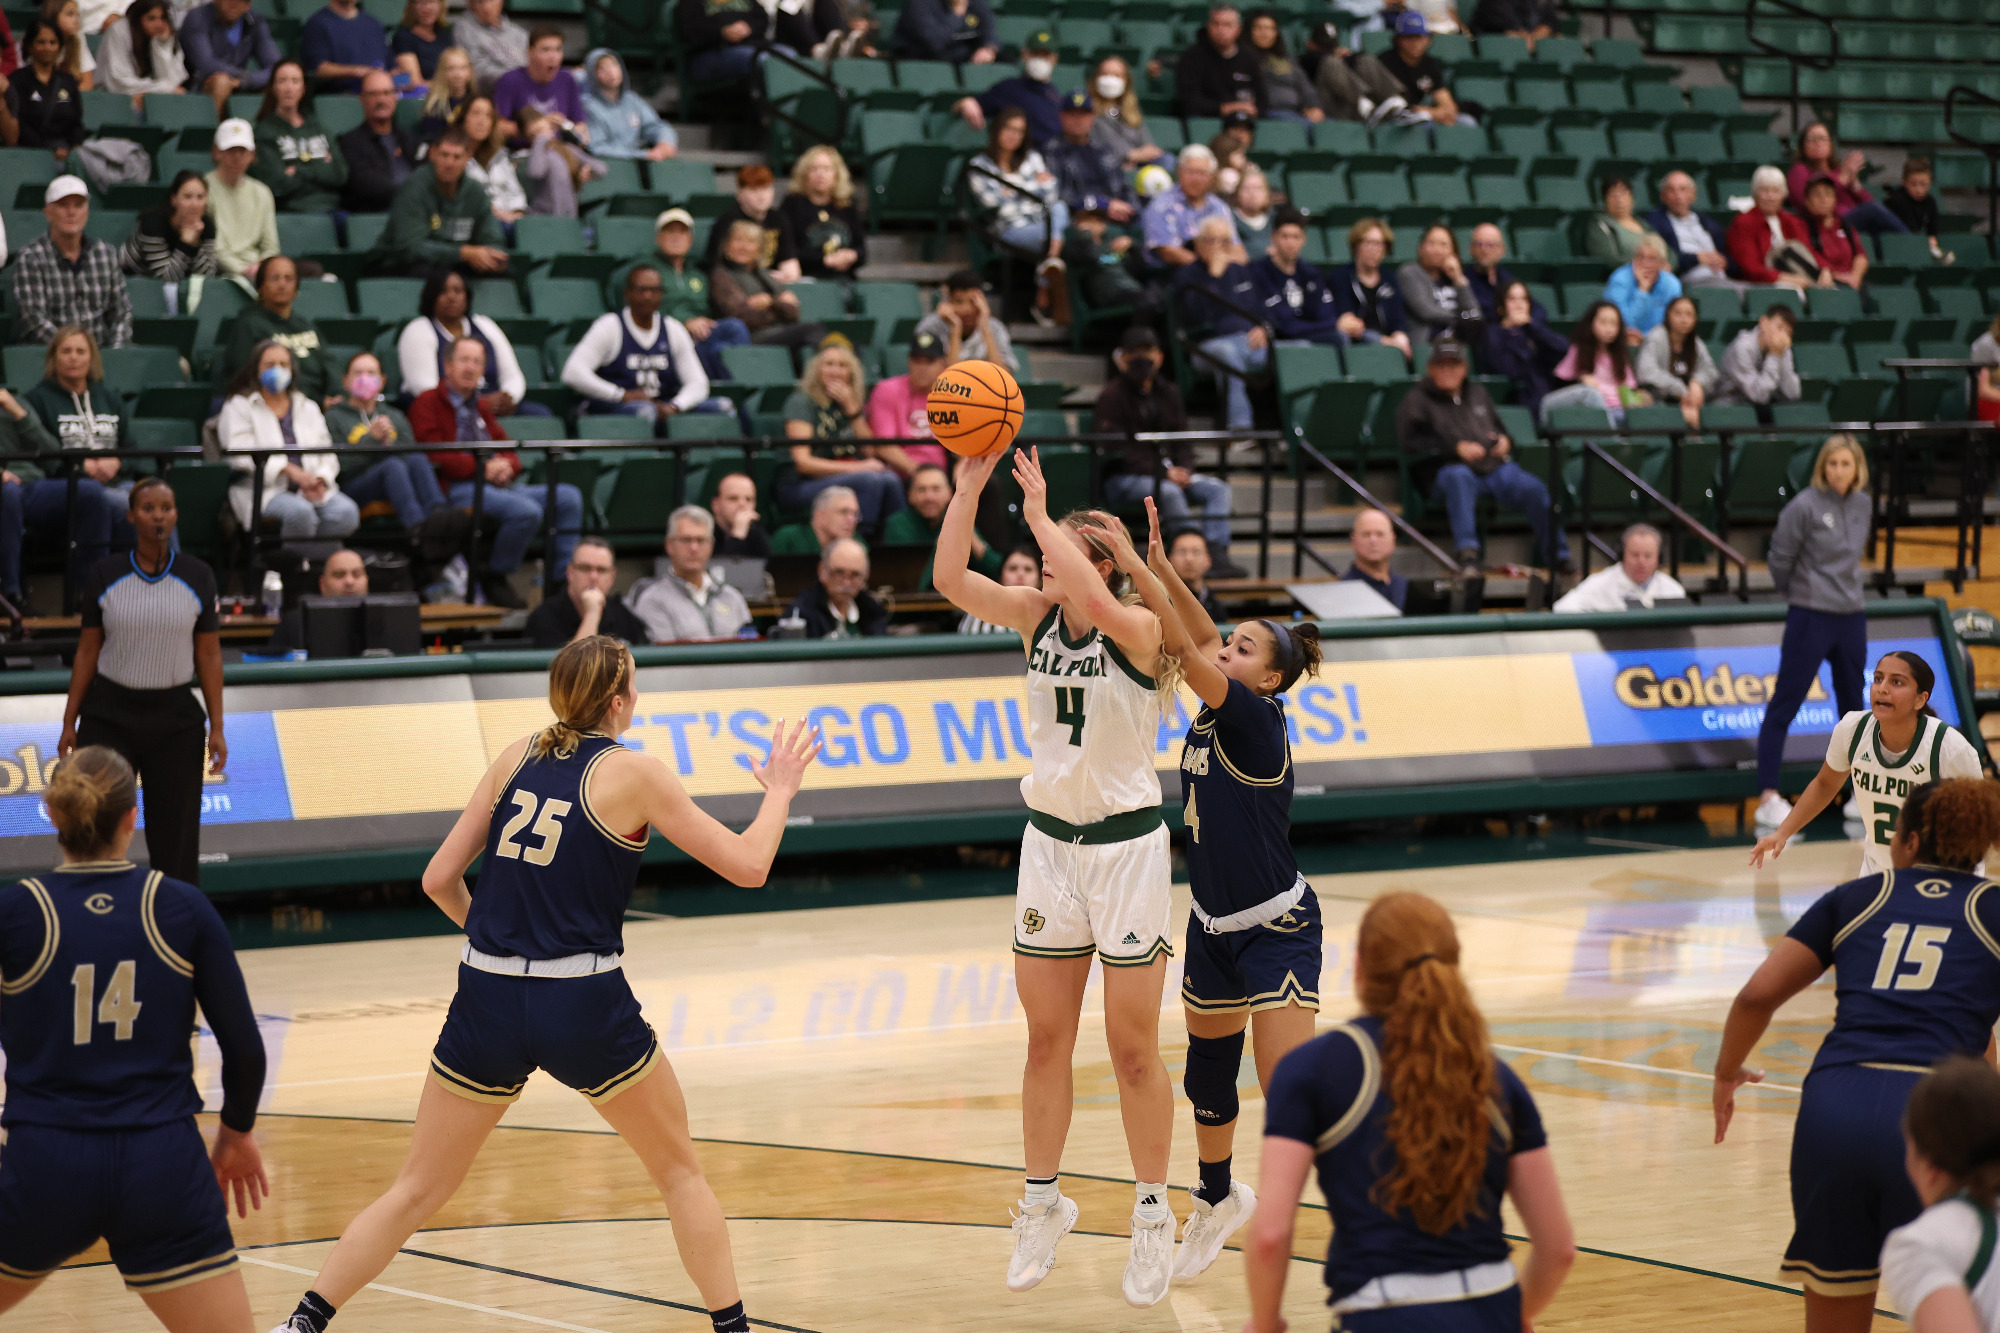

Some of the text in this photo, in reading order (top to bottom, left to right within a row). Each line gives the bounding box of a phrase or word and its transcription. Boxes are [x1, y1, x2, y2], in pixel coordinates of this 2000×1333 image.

[927, 410, 960, 426] NCAA
[930, 377, 972, 398] ilson
[1029, 647, 1063, 676] CAL
[807, 703, 911, 768] GO
[1055, 686, 1085, 747] 4
[1853, 767, 1882, 794] CAL
[496, 788, 573, 867] 25
[1183, 782, 1200, 844] 4
[1871, 922, 1952, 991] 15
[70, 959, 142, 1045] 14
